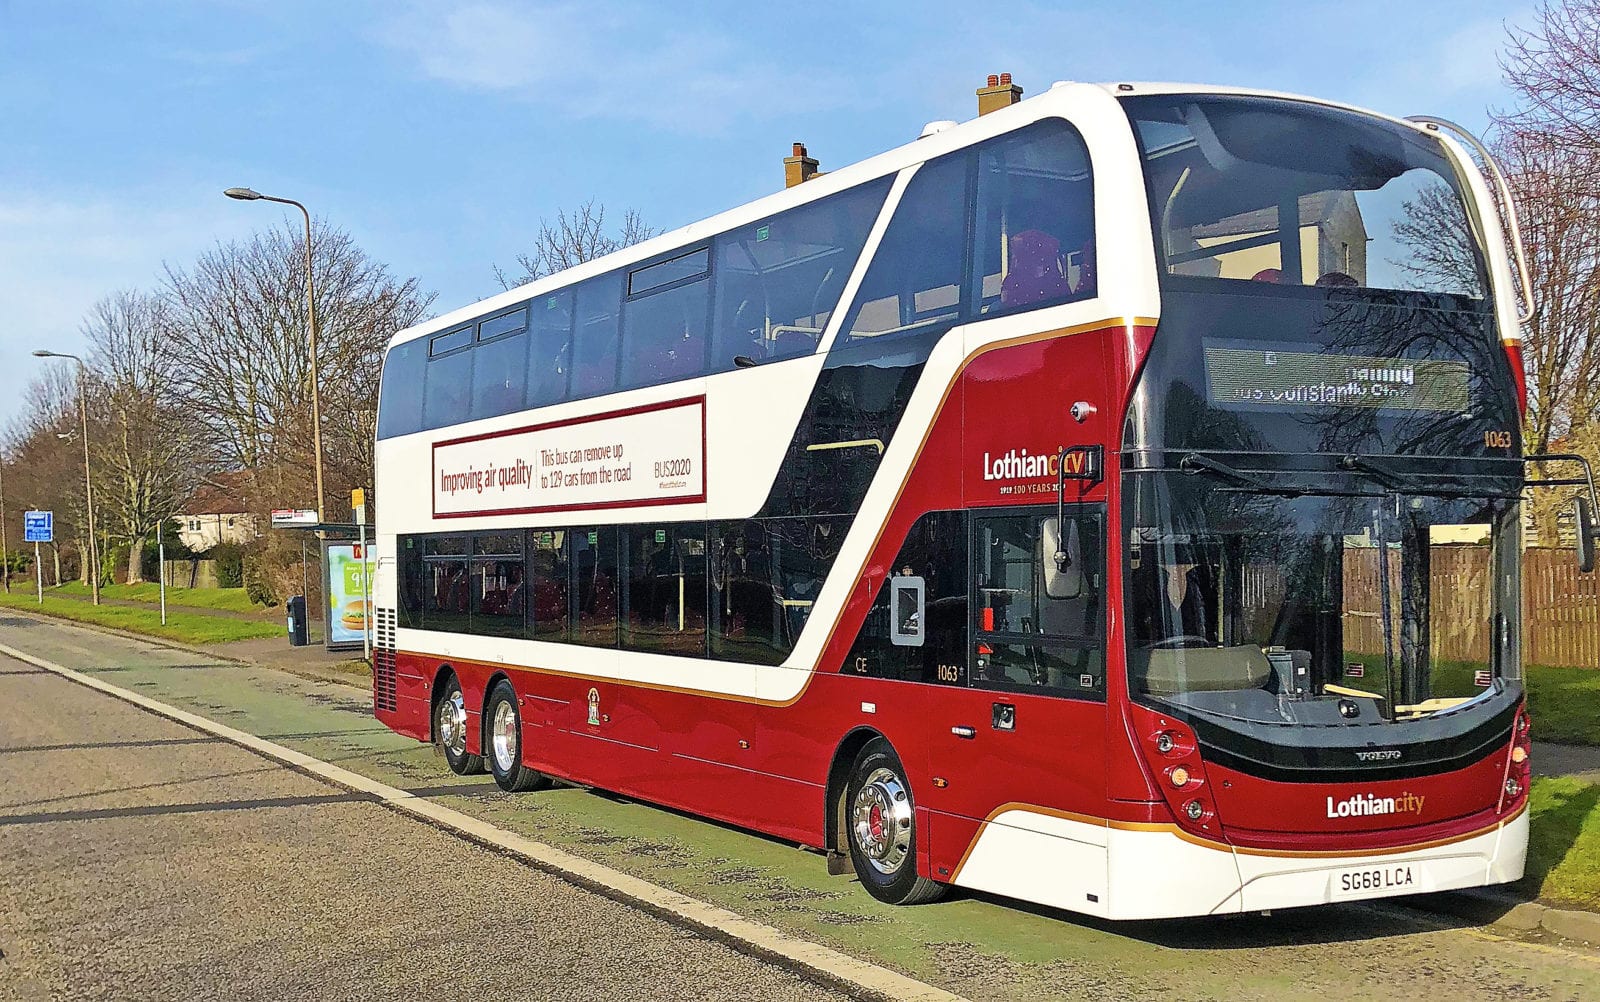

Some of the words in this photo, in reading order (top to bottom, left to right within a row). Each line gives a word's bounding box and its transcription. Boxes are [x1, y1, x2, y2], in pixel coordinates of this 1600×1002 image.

[1484, 431, 1511, 448] 1063
[540, 449, 555, 467] This
[555, 447, 569, 465] bus
[569, 449, 583, 463] can
[583, 445, 612, 462] remove
[612, 443, 624, 462] up
[441, 464, 483, 497] Improving
[484, 461, 497, 488] air
[498, 458, 533, 492] quality
[541, 473, 549, 489] to
[549, 470, 563, 488] 129
[564, 473, 579, 487] cars
[580, 467, 598, 486] from
[599, 465, 612, 484] the
[613, 461, 632, 483] road
[654, 458, 691, 478] BUS2020
[1013, 485, 1026, 494] 100
[1027, 483, 1051, 493] YEARS
[855, 657, 868, 673] CE
[938, 664, 958, 682] 1063
[1355, 750, 1402, 761] VOLVO
[1326, 791, 1426, 818] Lothiancity
[1341, 870, 1382, 891] SG68
[1385, 866, 1414, 887] LCA
